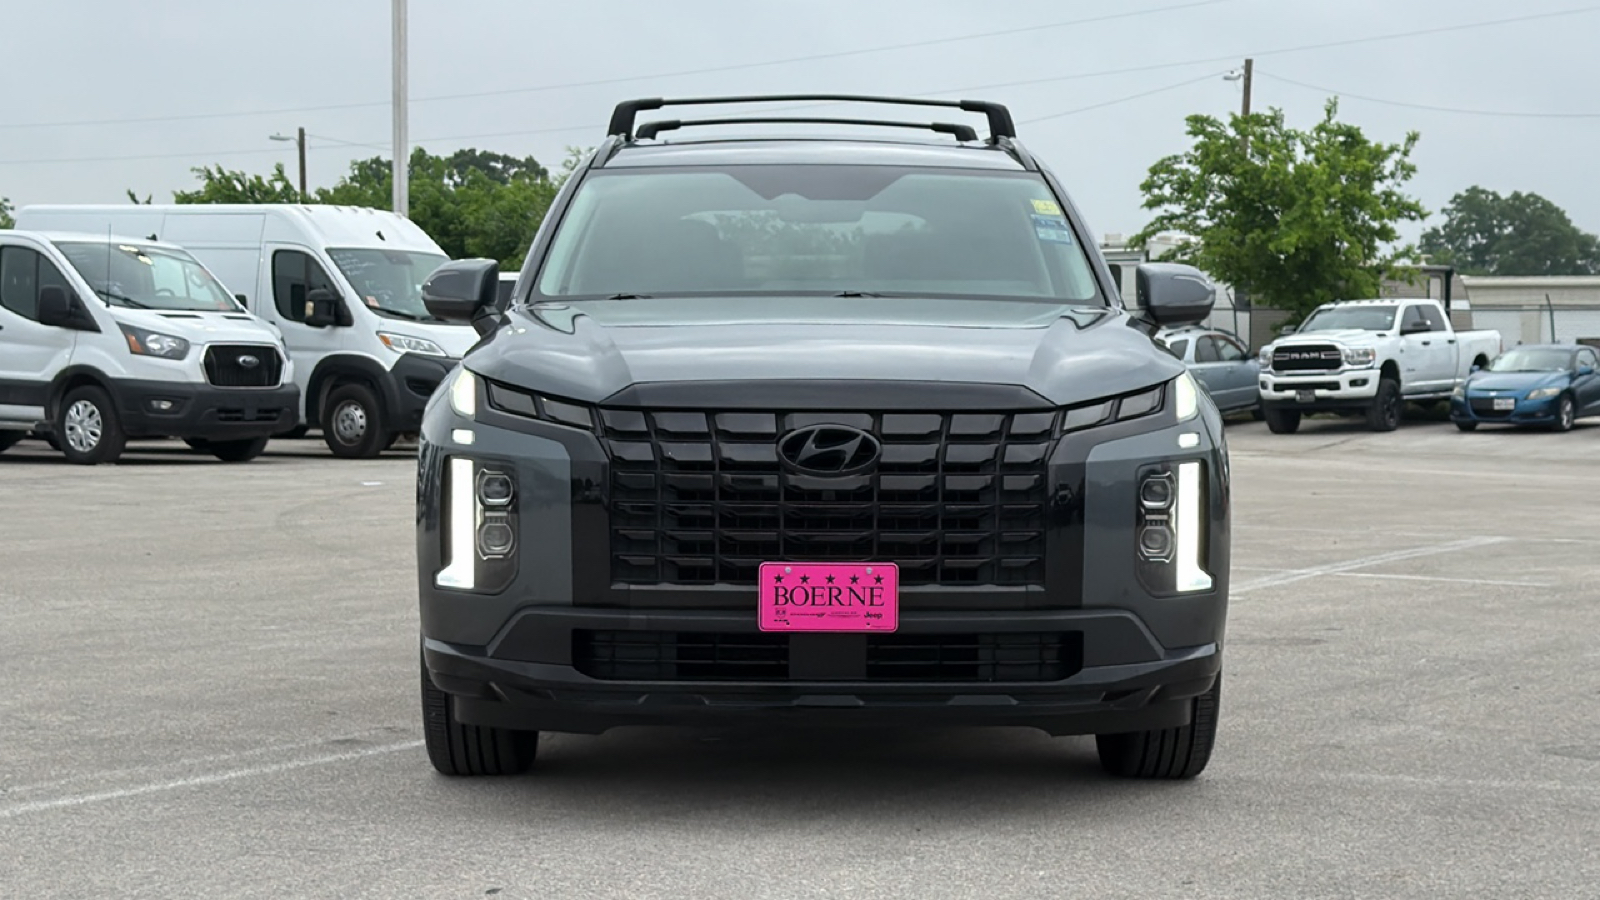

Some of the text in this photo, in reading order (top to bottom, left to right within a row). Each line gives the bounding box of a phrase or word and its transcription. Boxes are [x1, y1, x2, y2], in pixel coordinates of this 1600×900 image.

[1290, 352, 1319, 360] RAM
[773, 585, 885, 606] BOERNE
[863, 611, 883, 619] Jeep
